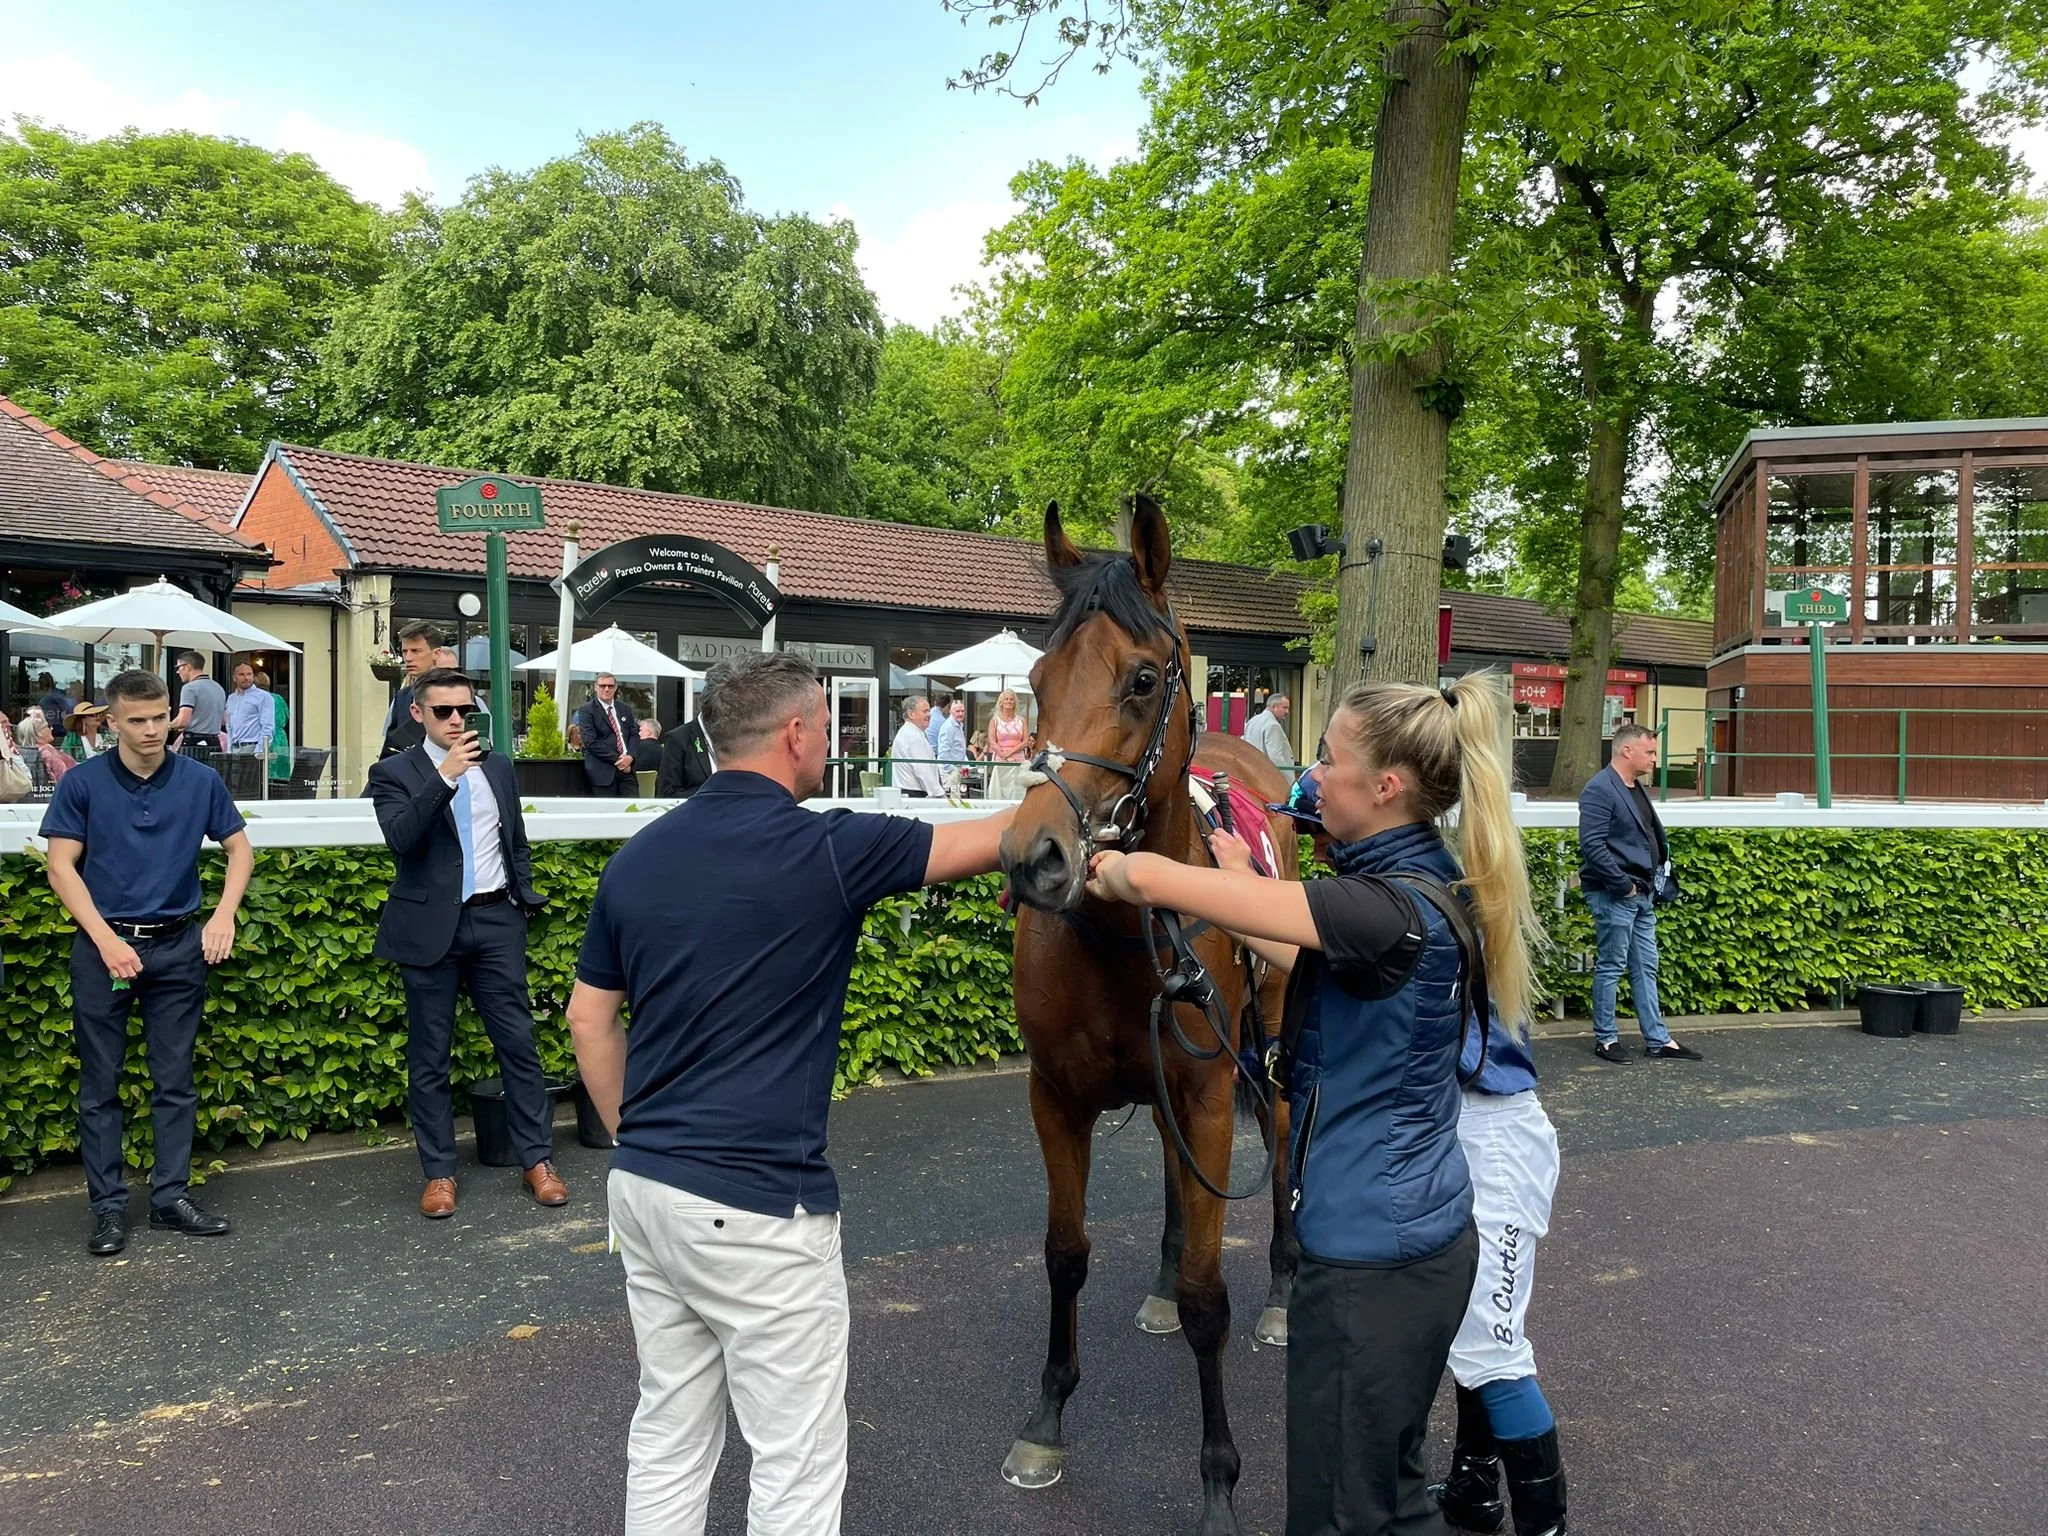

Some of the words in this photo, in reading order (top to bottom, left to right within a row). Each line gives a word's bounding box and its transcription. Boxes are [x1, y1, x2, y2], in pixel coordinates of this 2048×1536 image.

[450, 502, 532, 519] FOURTH
[649, 547, 689, 558] Welcome
[690, 551, 700, 560] to
[701, 552, 715, 564] the
[576, 567, 609, 598] Pareto
[614, 565, 642, 578] Pareto
[644, 562, 675, 571] Owners
[676, 562, 684, 571] &
[685, 562, 715, 577] Trainers
[716, 569, 744, 590] Pavilion
[748, 580, 775, 611] Pareto
[1797, 603, 1836, 615] THIRD
[1491, 1223, 1520, 1313] Curtis
[1493, 1317, 1513, 1347] B.
